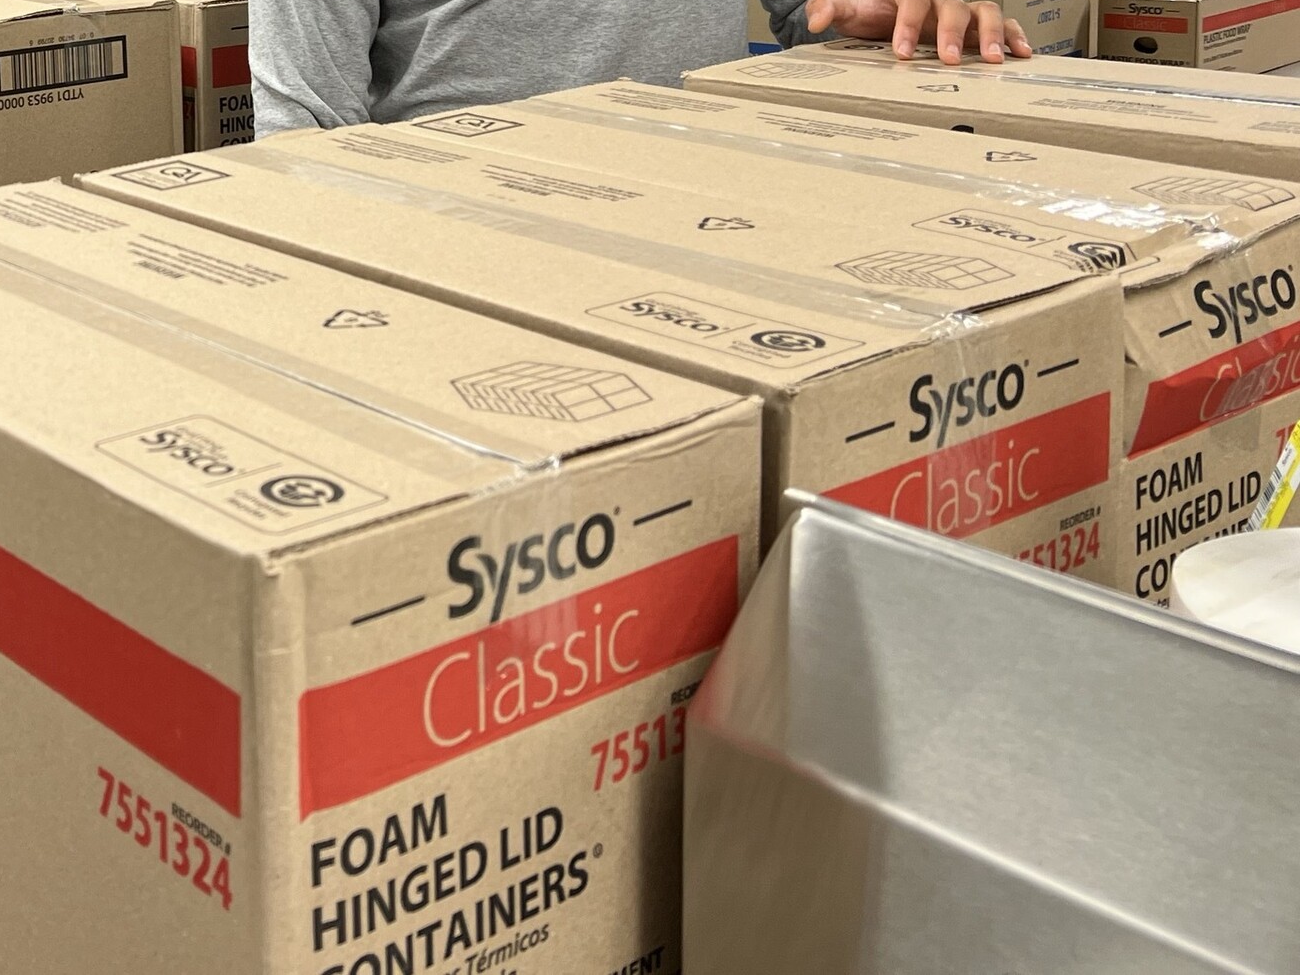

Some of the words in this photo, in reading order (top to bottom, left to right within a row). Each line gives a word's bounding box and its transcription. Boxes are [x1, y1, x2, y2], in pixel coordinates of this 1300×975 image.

[1128, 3, 1164, 15] Sysco
[1203, 31, 1223, 45] PLASTIC
[1223, 27, 1236, 40] FOOD
[1134, 57, 1159, 65] FOOD
[220, 114, 255, 135] HING
[939, 216, 1036, 242] Sysco
[619, 301, 720, 332] Sysco
[1194, 268, 1297, 345] Sysco
[908, 362, 1027, 449] Sysco
[138, 429, 235, 475] Sysco
[890, 441, 1042, 537] Classic
[1135, 451, 1204, 511] FOAM
[1059, 507, 1095, 532] REORDER
[1136, 488, 1223, 557] HINGED
[1228, 470, 1262, 514] LID
[447, 508, 619, 624] Sysco
[1017, 521, 1100, 573] 51324
[423, 603, 640, 747] Classic
[590, 705, 687, 793] 75513
[97, 765, 233, 912] 7551324
[170, 802, 223, 850] REORDER
[309, 793, 449, 889] FOAM
[311, 840, 489, 952] HINGED
[499, 805, 564, 873] LID
[463, 922, 550, 975] Térmicos
